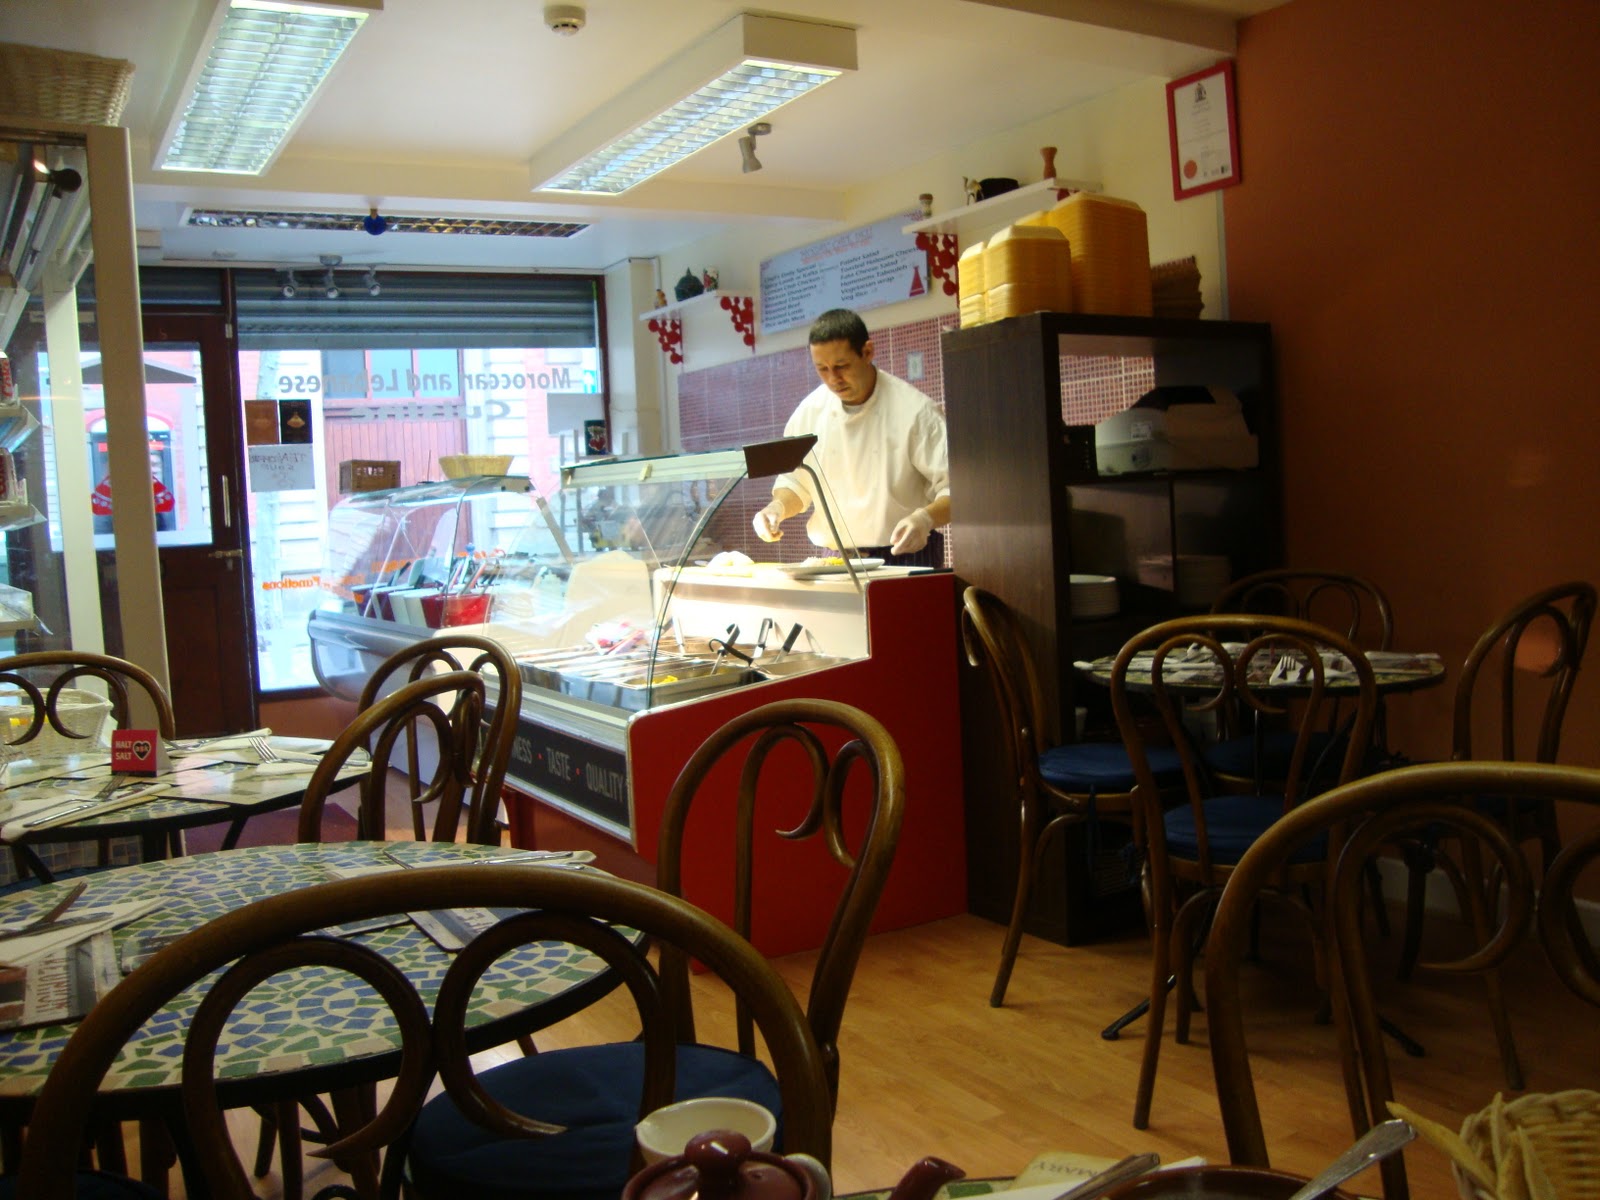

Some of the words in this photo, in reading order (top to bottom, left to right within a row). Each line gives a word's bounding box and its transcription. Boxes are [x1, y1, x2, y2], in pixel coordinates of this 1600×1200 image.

[862, 249, 879, 259] Salad
[855, 264, 878, 275] Cheese
[880, 258, 897, 268] Salad
[797, 275, 819, 286] Chicken
[840, 280, 875, 295] Vegetarian
[841, 293, 853, 302] Veg
[115, 740, 132, 749] HALT
[115, 752, 132, 761] SALT
[545, 747, 571, 781] TASTE
[585, 762, 624, 803] QUALITY
